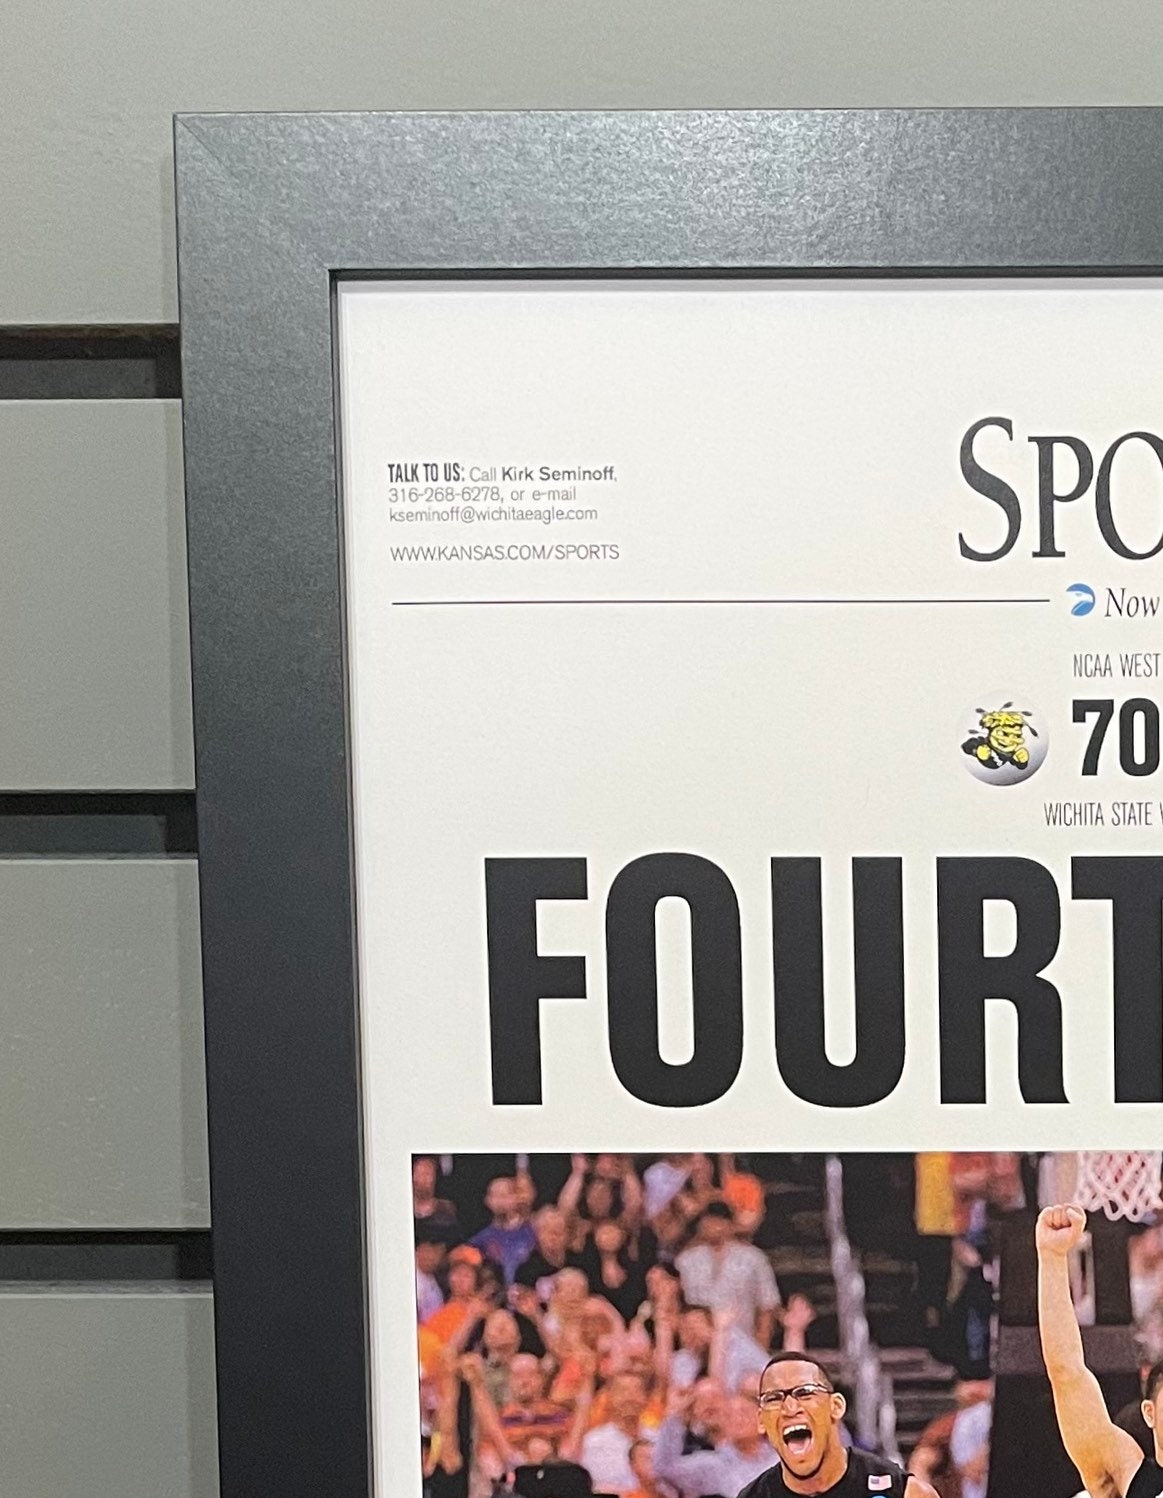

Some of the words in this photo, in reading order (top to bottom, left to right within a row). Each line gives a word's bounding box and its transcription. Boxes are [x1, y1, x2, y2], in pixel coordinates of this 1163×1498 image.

[387, 463, 420, 483] TALK
[422, 462, 439, 483] TO
[443, 462, 465, 482] US:
[469, 466, 497, 483] Call
[501, 466, 534, 482] Kirk
[539, 465, 617, 482] Seminoff,
[388, 486, 504, 504] 316-268-6278,
[510, 490, 525, 501] or
[532, 486, 576, 501] e-mail
[389, 505, 598, 525] kseminoff@wichitaeagle.com
[390, 544, 620, 562] WWW.KANSAS.COM/SPORTS
[1104, 587, 1160, 618] Now
[1073, 653, 1113, 678] NCAA
[1119, 653, 1161, 678] WEST
[1043, 802, 1105, 827] WICHITA
[1111, 801, 1153, 826] STATE
